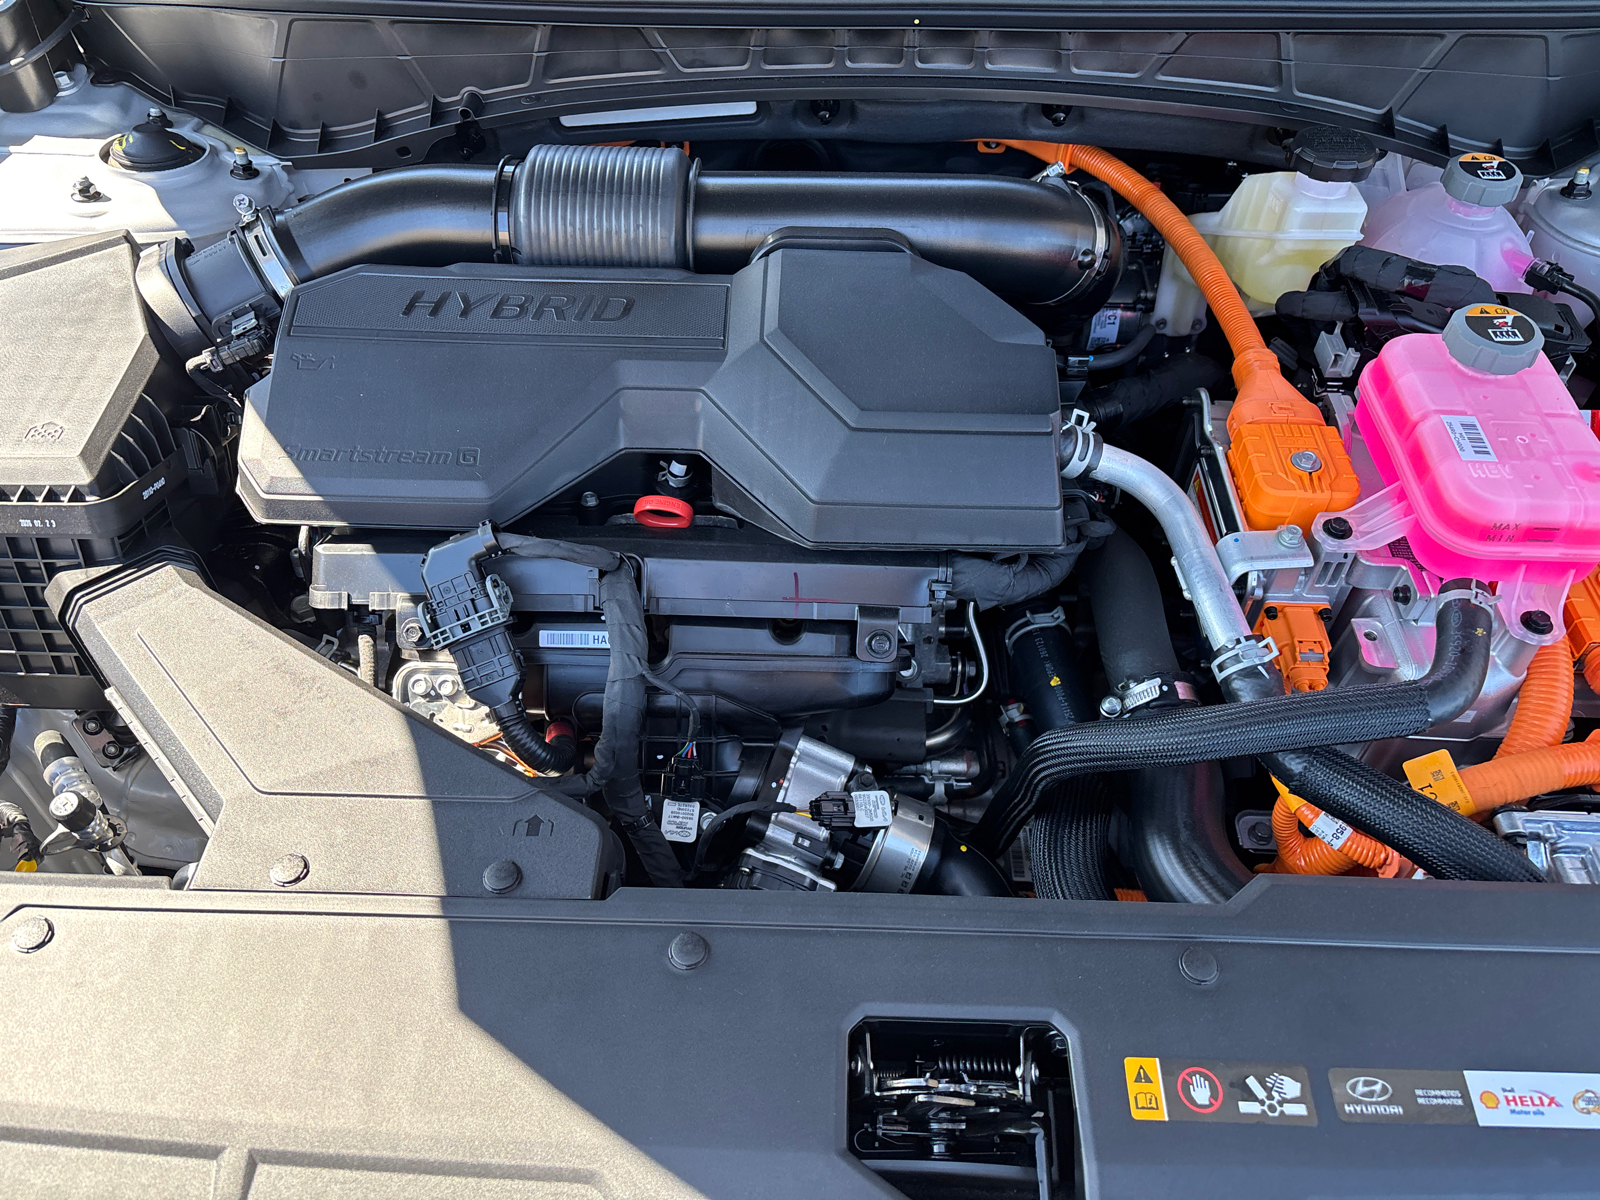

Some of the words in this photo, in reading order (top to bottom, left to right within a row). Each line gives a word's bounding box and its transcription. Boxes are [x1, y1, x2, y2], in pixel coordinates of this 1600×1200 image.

[400, 290, 636, 322] HYBRID
[280, 445, 452, 465] Smartstream
[458, 446, 480, 467] G
[1468, 463, 1514, 479] HEV
[644, 498, 654, 506] OIL
[655, 498, 682, 510] ENGINE
[1491, 523, 1521, 531] MAX
[1485, 534, 1515, 542] MIN
[593, 635, 611, 645] HA
[1414, 1088, 1461, 1097] RECOMMENDS
[1416, 1097, 1464, 1106] RECOMMANDE
[1503, 1094, 1561, 1107] HELIX
[1344, 1103, 1403, 1115] HYUNDAI
